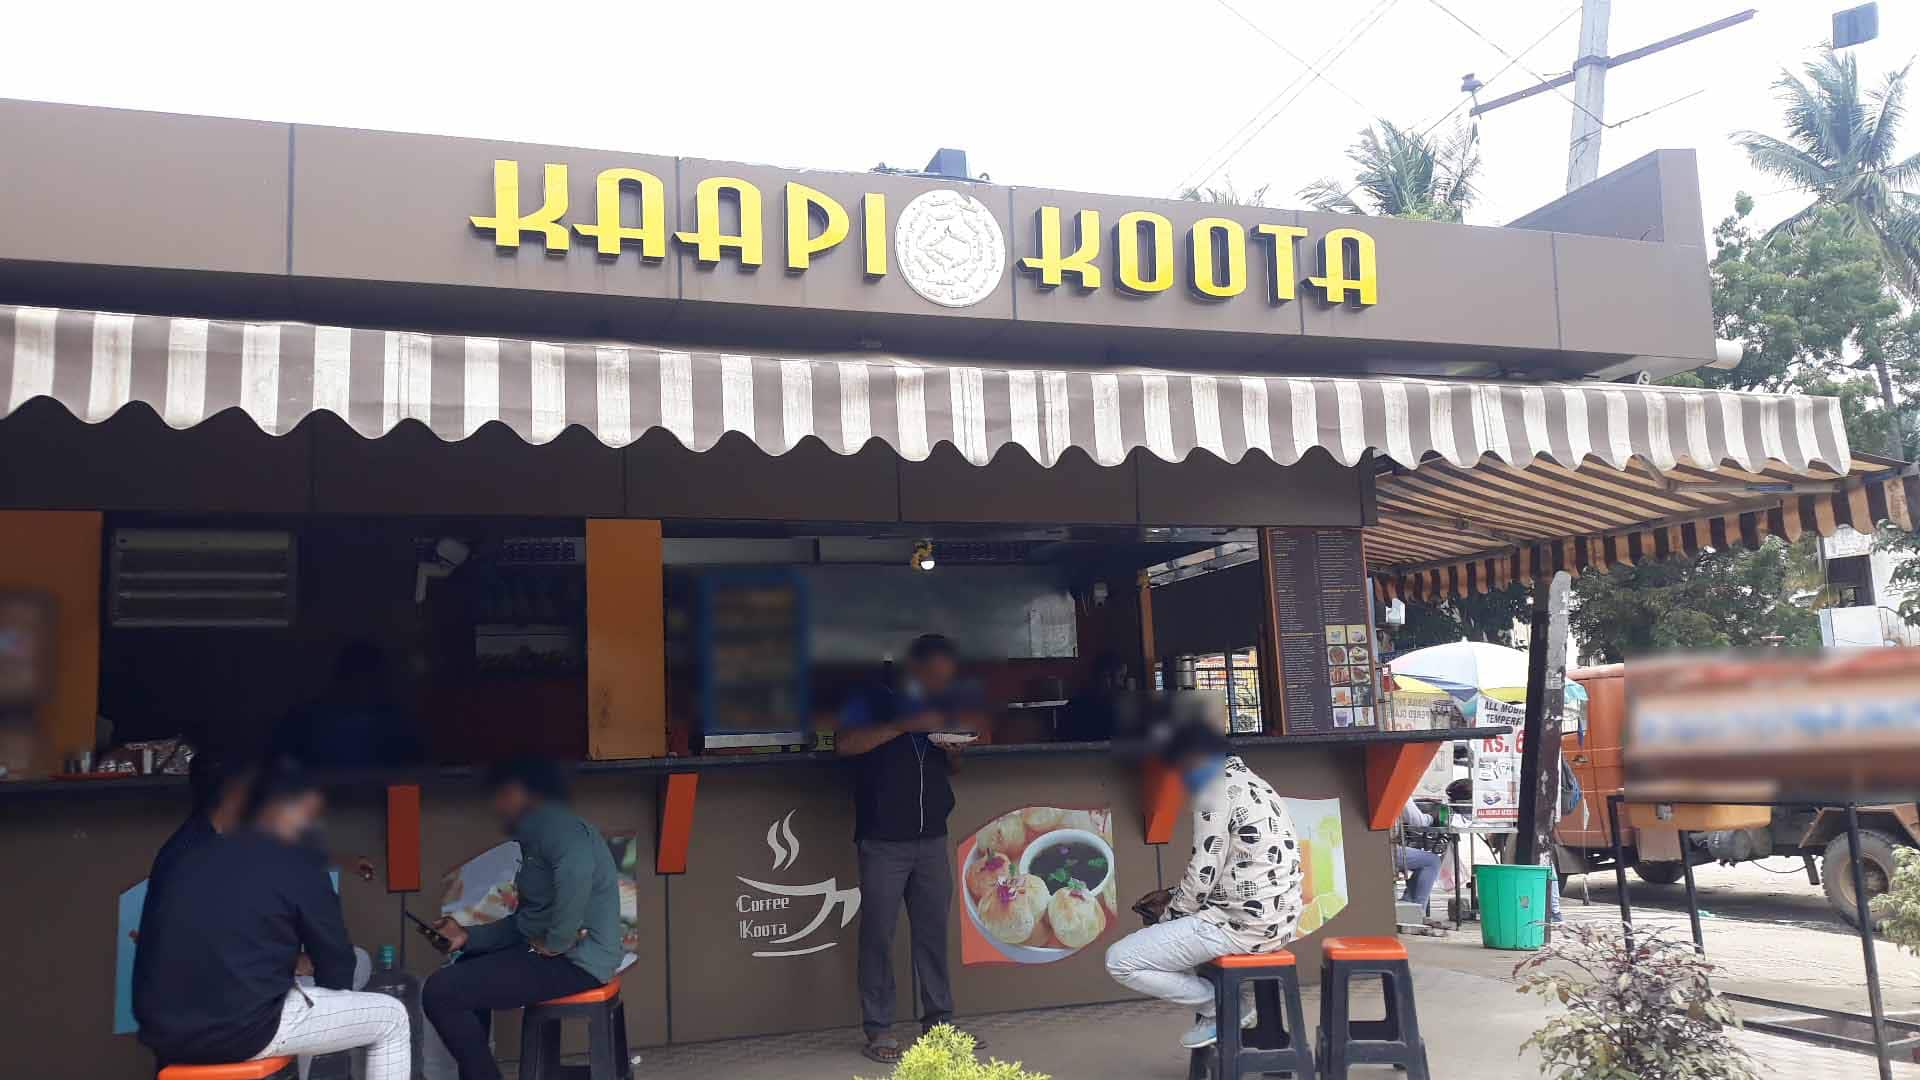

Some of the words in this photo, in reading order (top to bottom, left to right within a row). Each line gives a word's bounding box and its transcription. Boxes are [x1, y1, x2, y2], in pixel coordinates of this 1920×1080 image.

[469, 159, 888, 276] KAAPI
[1016, 206, 1377, 305] KOOTA
[1485, 701, 1498, 711] ALL
[736, 895, 790, 912] Coffee
